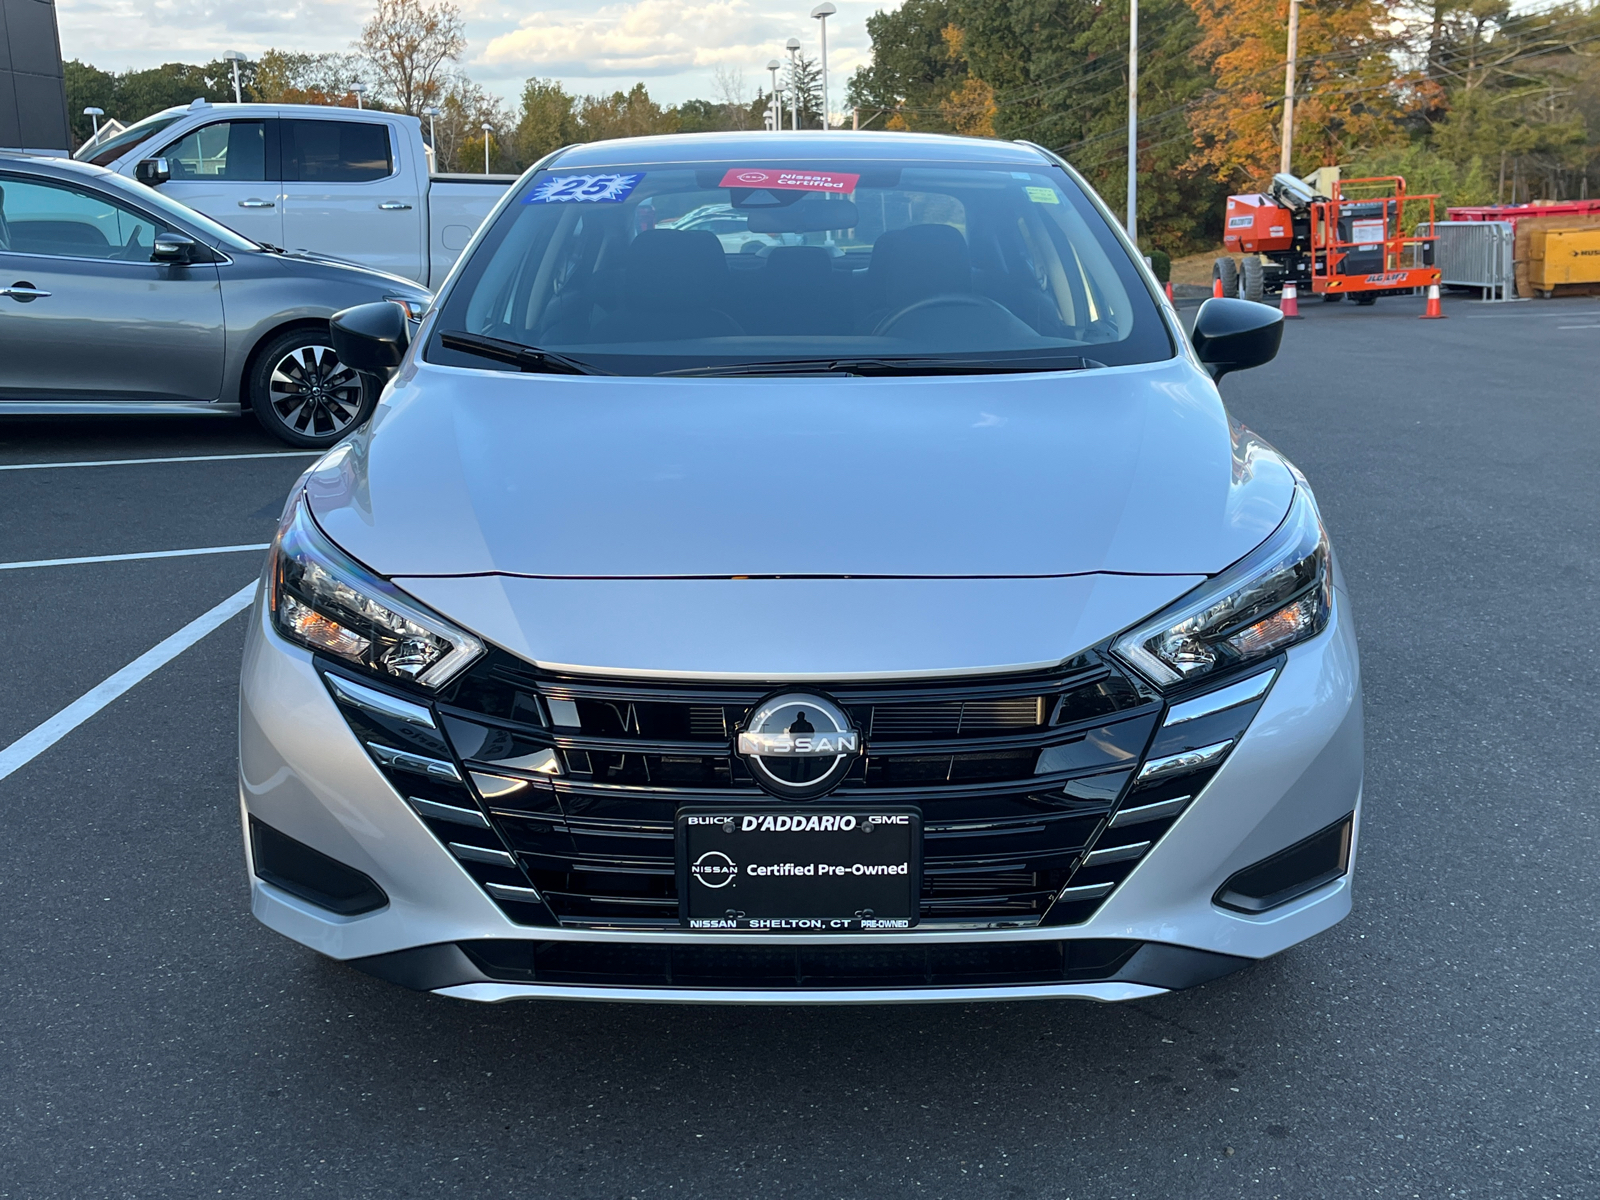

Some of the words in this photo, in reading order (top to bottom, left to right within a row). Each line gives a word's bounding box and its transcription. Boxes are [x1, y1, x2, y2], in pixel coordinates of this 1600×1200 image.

[777, 179, 844, 188] Certified
[780, 174, 831, 182] Nissan
[551, 178, 615, 196] 25
[741, 735, 856, 753] NISSAN
[688, 816, 734, 825] BUICK
[741, 815, 857, 831] D'ADDARIO
[868, 815, 909, 825] GMC
[691, 865, 738, 874] NISSAN
[746, 863, 814, 876] Certified
[818, 862, 908, 876] Pre-Owned
[690, 919, 737, 929] NISSAN
[749, 919, 826, 930] SHELTON,
[830, 919, 852, 928] CT
[861, 919, 909, 929] PRE-OWNED
